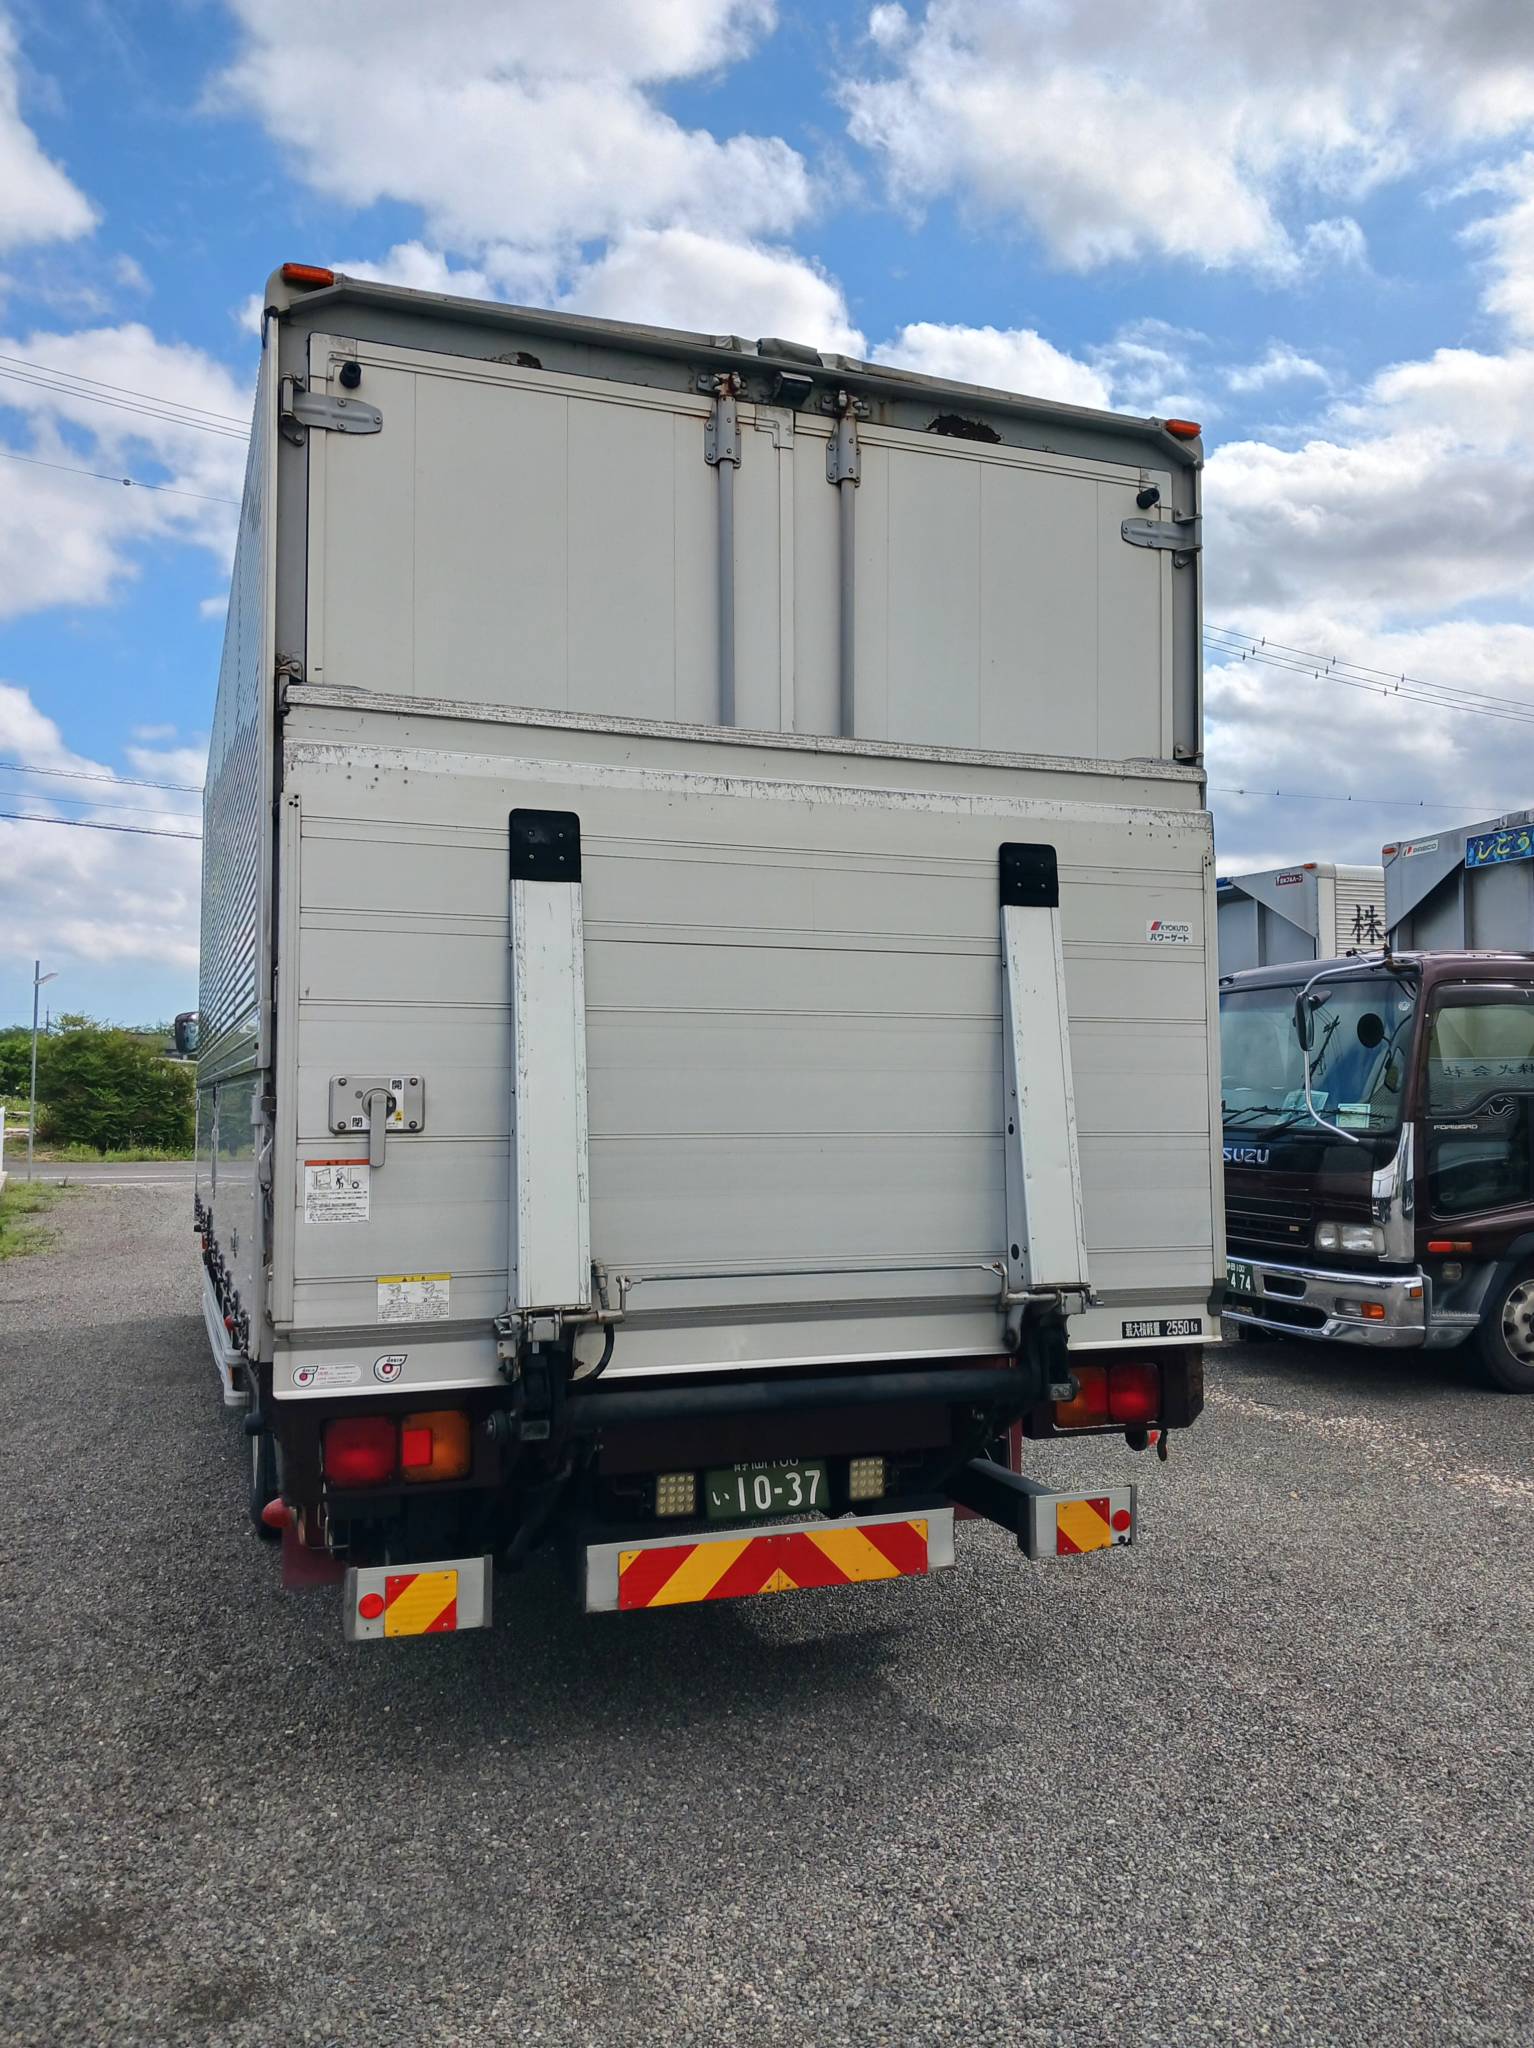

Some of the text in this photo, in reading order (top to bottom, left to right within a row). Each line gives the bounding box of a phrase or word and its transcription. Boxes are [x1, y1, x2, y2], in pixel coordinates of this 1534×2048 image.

[1351, 904, 1384, 944] 株
[1150, 933, 1189, 942] パワーゲート
[1223, 1147, 1270, 1164] SUZU
[1166, 1320, 1190, 1335] 2550
[712, 1469, 821, 1513] い 10-37
